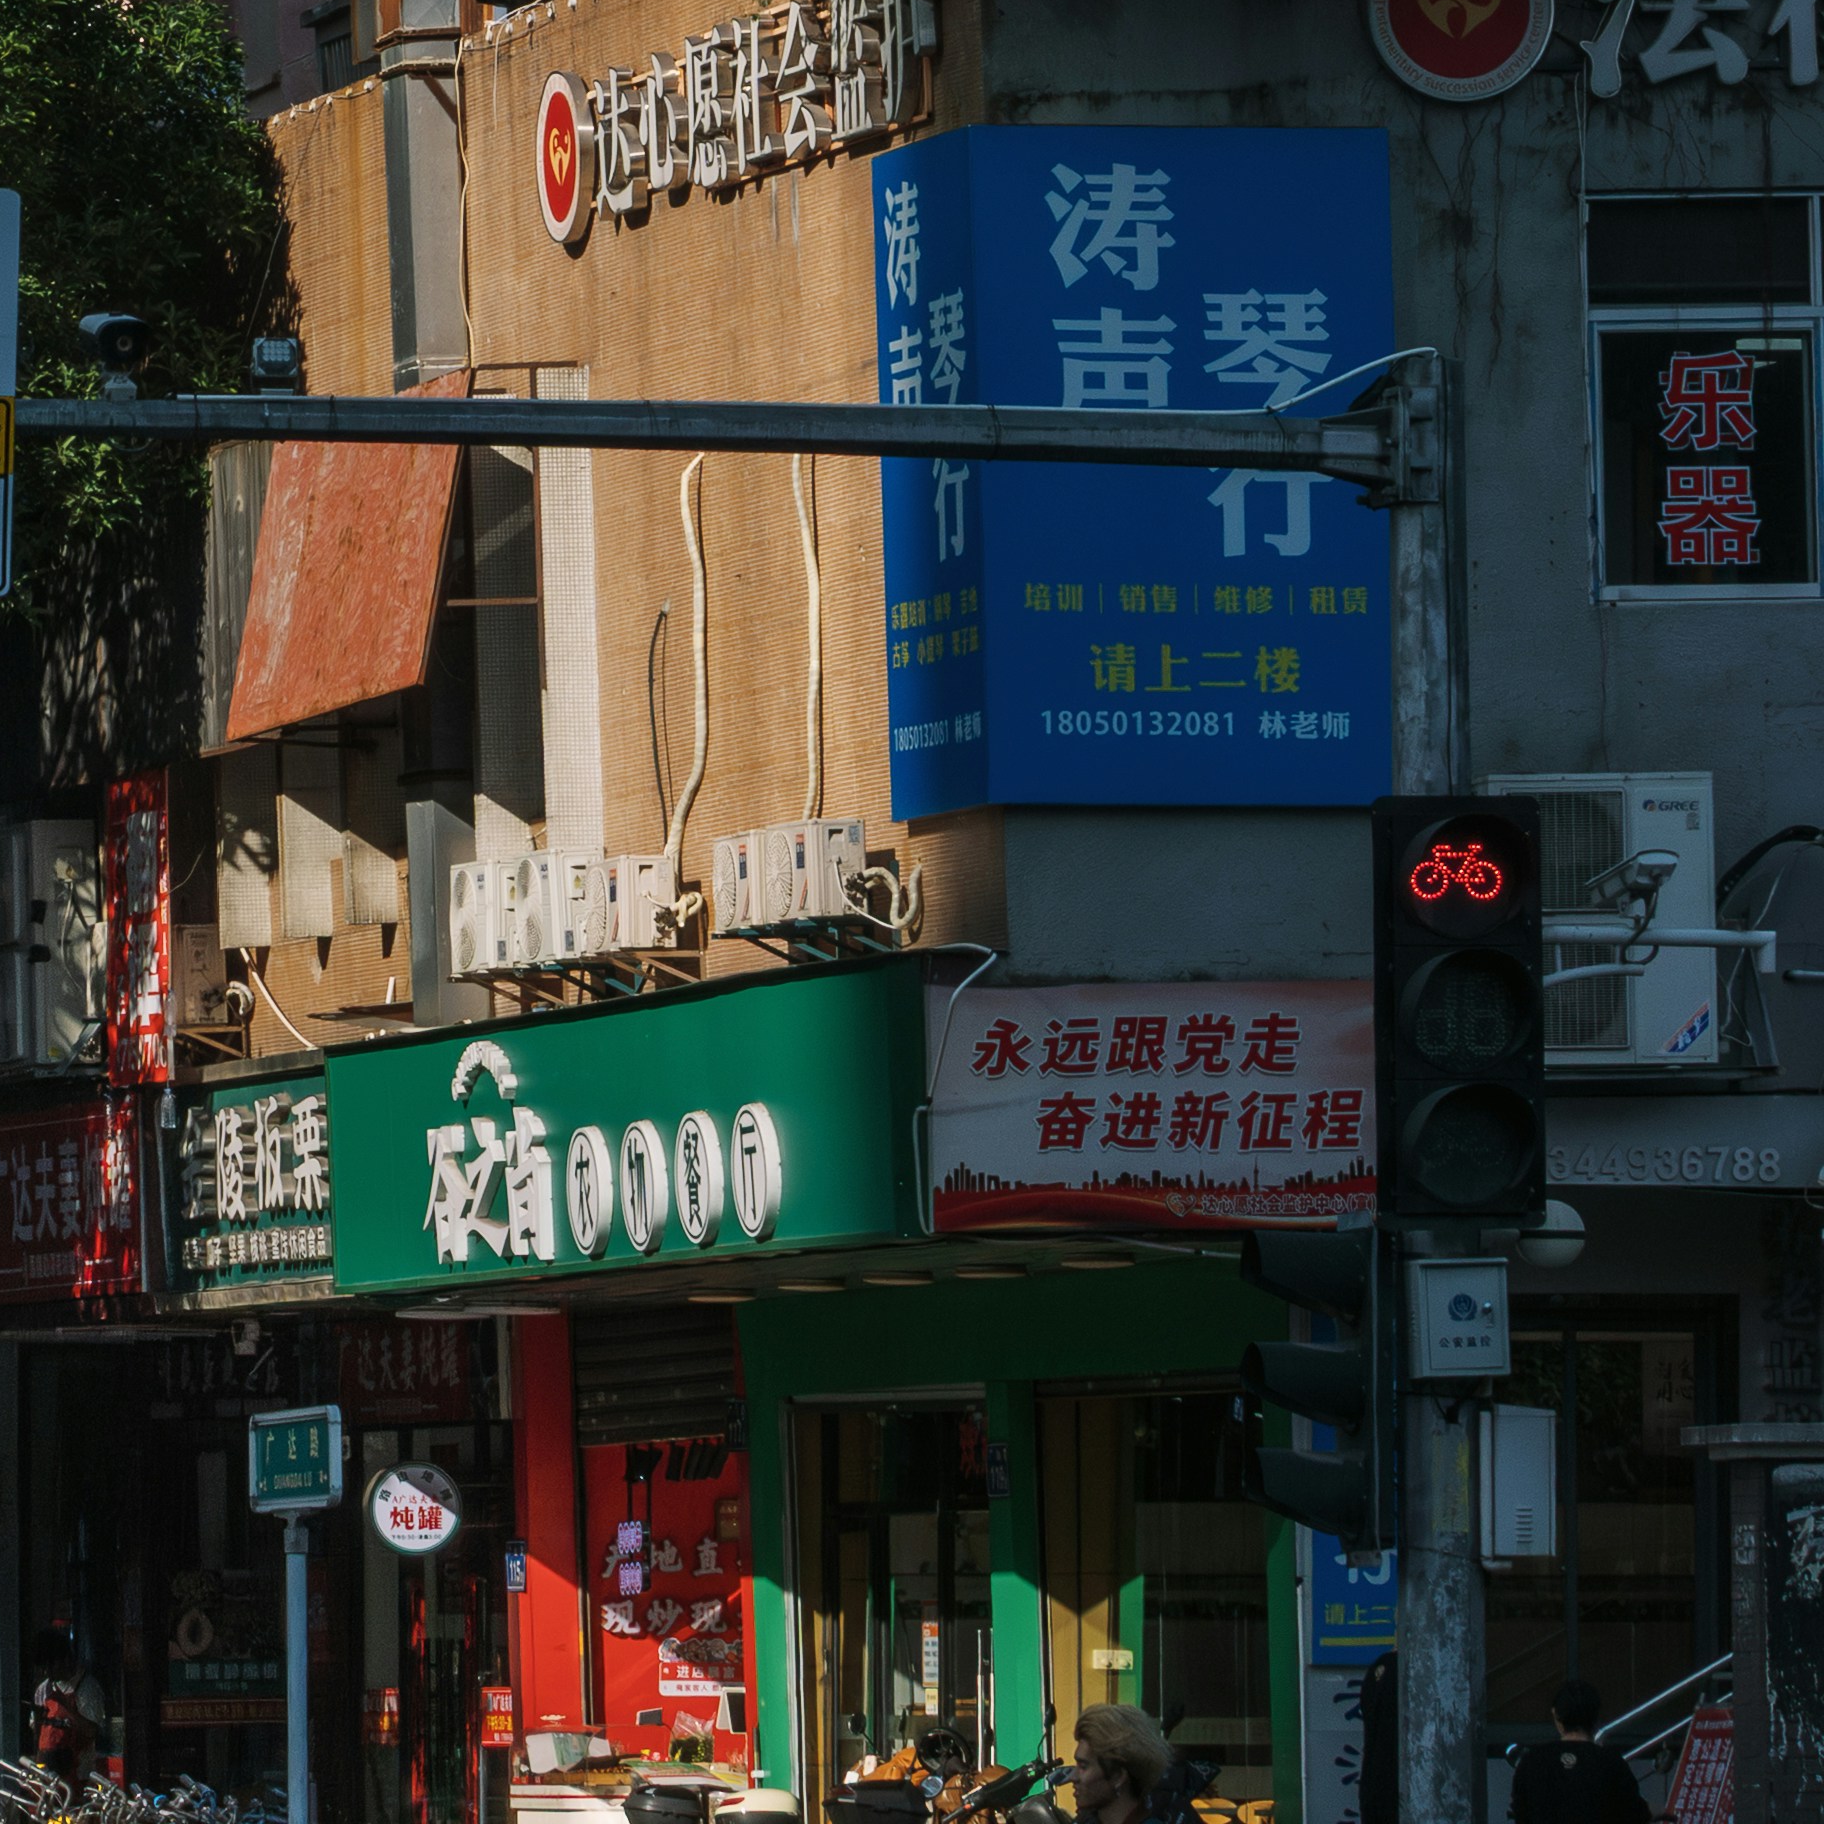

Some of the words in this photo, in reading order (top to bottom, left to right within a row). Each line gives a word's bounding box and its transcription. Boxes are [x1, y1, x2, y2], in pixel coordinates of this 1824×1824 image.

[1044, 163, 1177, 409] 涛声
[1658, 349, 1761, 566] 乐器
[1025, 583, 1084, 613] 培训
[1118, 583, 1179, 613] 销售
[1213, 584, 1274, 614] 维修
[1309, 585, 1369, 615] 租赁
[1090, 644, 1301, 694] 请上二楼
[894, 719, 950, 753] 18050132081
[1041, 710, 1236, 737] 18050132081
[1259, 710, 1350, 740] 林老师
[1659, 799, 1700, 812] GREE
[971, 1012, 1301, 1077] 永远跟党走
[1035, 1089, 1364, 1151] 奋进新征程
[1438, 1335, 1492, 1350] 公安监控
[266, 1425, 319, 1464] 广达路
[390, 1506, 443, 1530] 炖罐
[602, 1538, 742, 1578] 产地直
[601, 1597, 742, 1637] 现炒现
